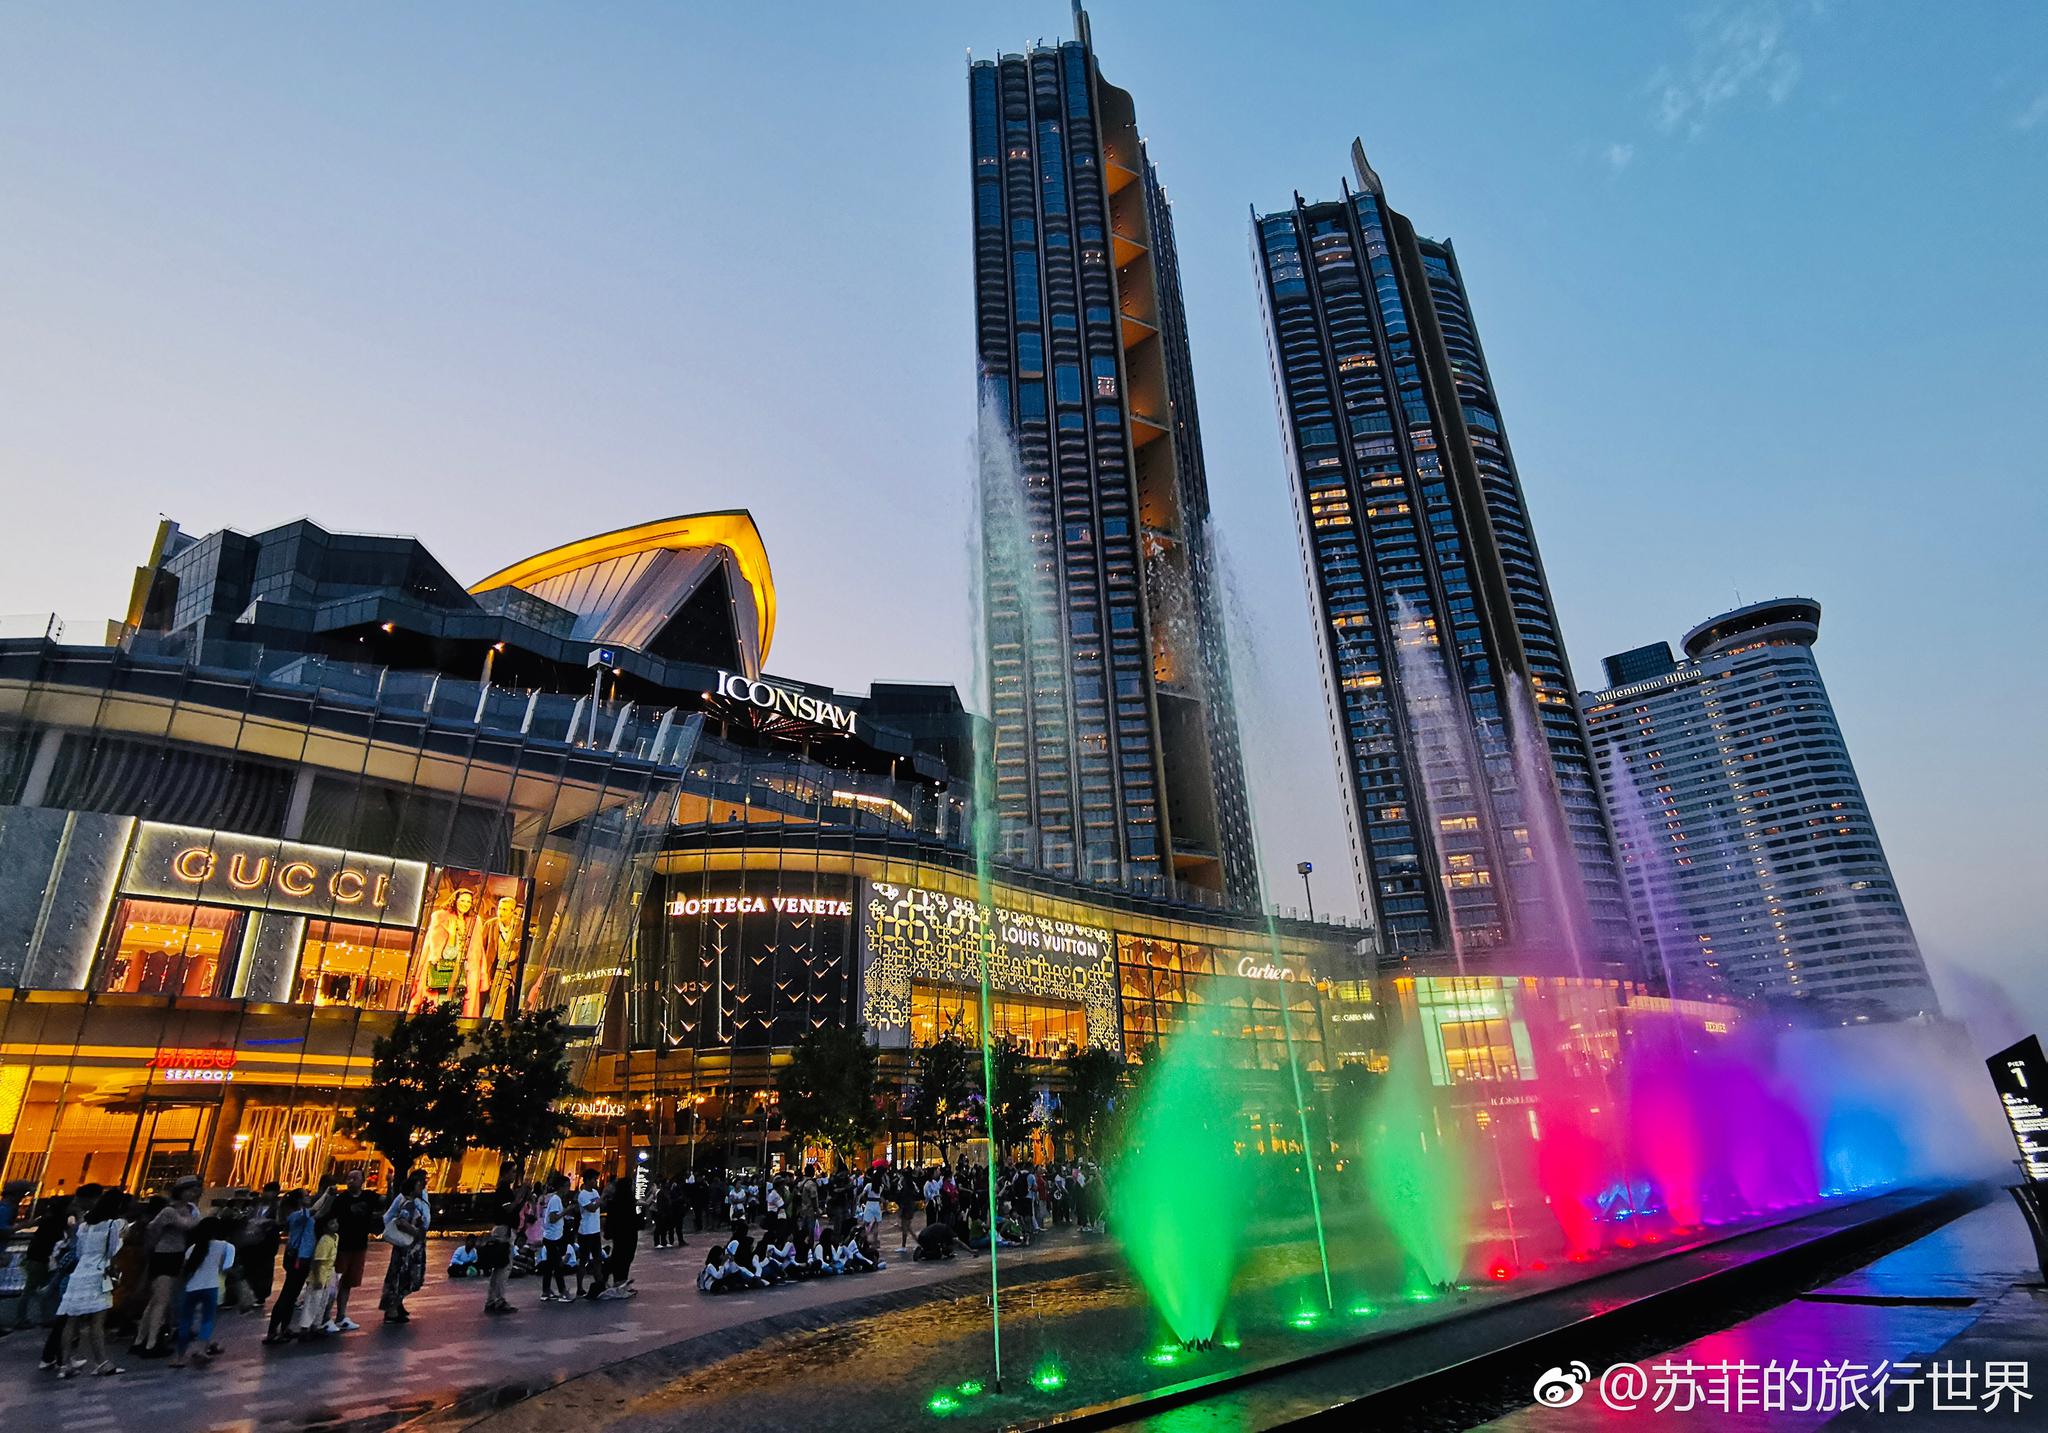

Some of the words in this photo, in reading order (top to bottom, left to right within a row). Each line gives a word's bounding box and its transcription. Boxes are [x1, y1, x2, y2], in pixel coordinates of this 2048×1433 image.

[1594, 680, 1662, 704] Millennium
[1664, 669, 1702, 685] Hilton
[716, 670, 858, 735] ICONSIAM
[174, 846, 390, 908] GUCCI
[668, 896, 767, 916] BOTTEGA
[772, 896, 851, 917] VENETA
[1001, 925, 1041, 948] LOUIS
[1042, 933, 1099, 959] VUITTON
[1237, 956, 1294, 983] Cartier
[164, 1068, 234, 1082] SEAFOOD
[2010, 1067, 2028, 1088] 1
